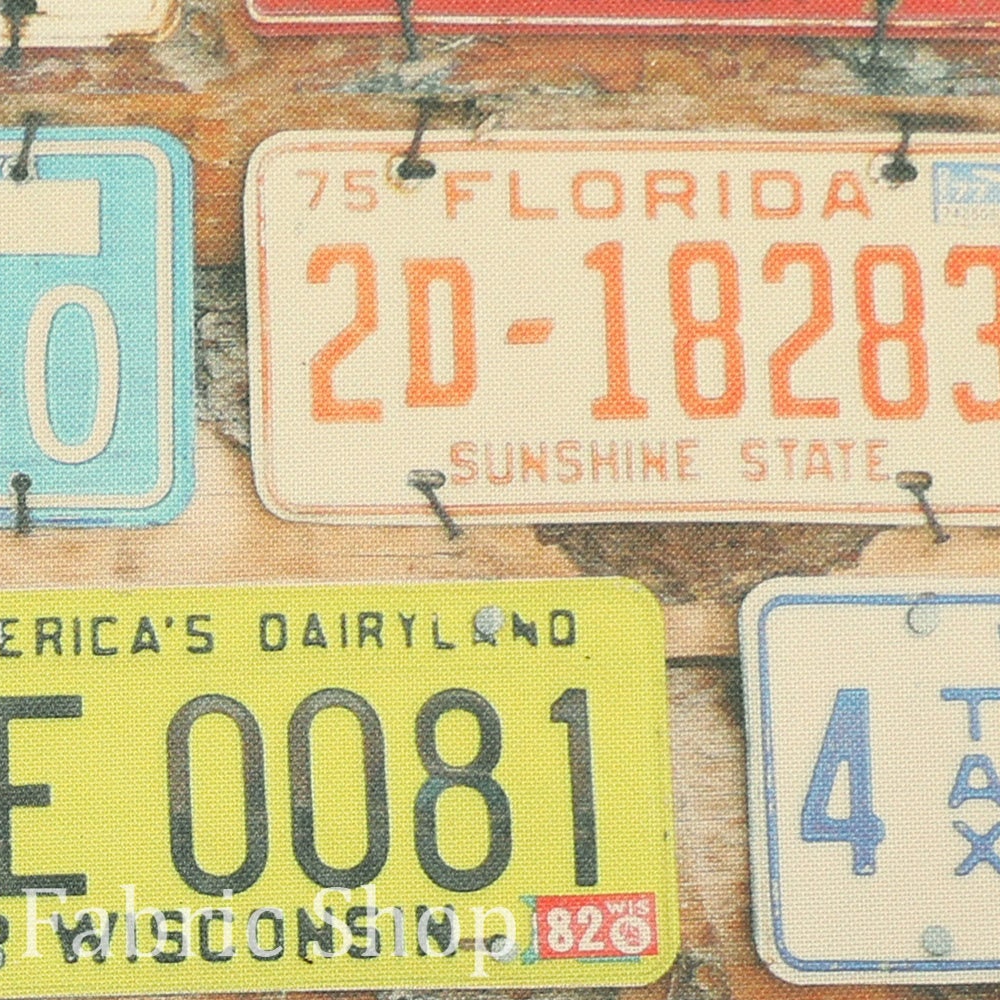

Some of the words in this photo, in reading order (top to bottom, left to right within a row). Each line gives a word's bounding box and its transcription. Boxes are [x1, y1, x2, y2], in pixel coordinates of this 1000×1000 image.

[297, 170, 379, 212] 75
[444, 169, 873, 221] FLORIDA
[448, 438, 703, 487] SUNSHINE
[740, 438, 893, 483] STATE
[165, 686, 600, 898] 0081
[799, 687, 887, 877] 4
[547, 906, 606, 953] 82
[605, 899, 650, 915] WIS
[52, 904, 457, 963] WISCONSIN
